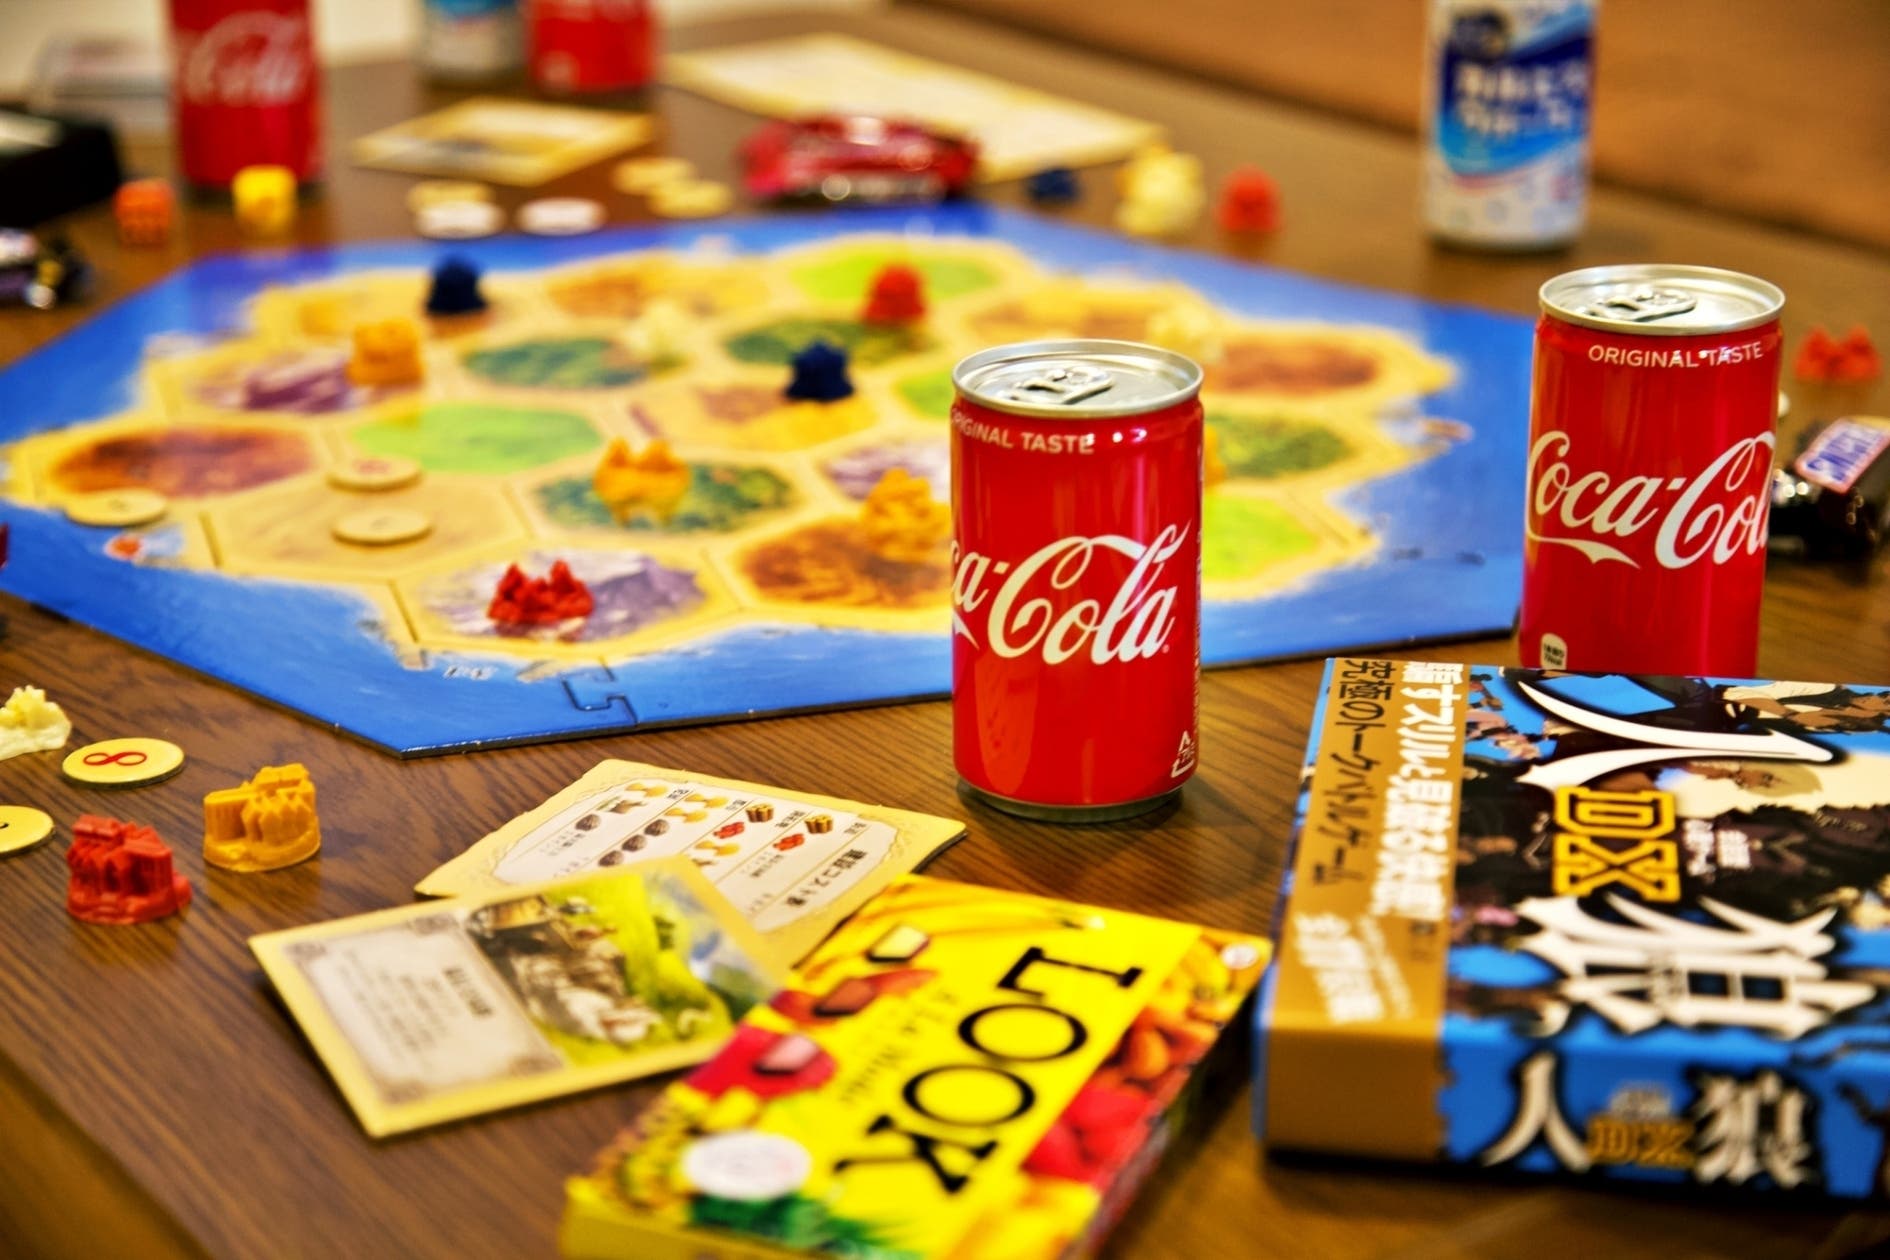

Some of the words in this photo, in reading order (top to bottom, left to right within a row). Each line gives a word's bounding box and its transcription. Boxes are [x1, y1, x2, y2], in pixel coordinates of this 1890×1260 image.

[1588, 344, 1699, 368] ORIGINAL
[1700, 341, 1764, 366] TASTE
[1020, 431, 1095, 455] TASTE
[1524, 430, 1776, 570] Coca-Col
[1553, 785, 1682, 902] DX
[833, 945, 1145, 1196] LOOK
